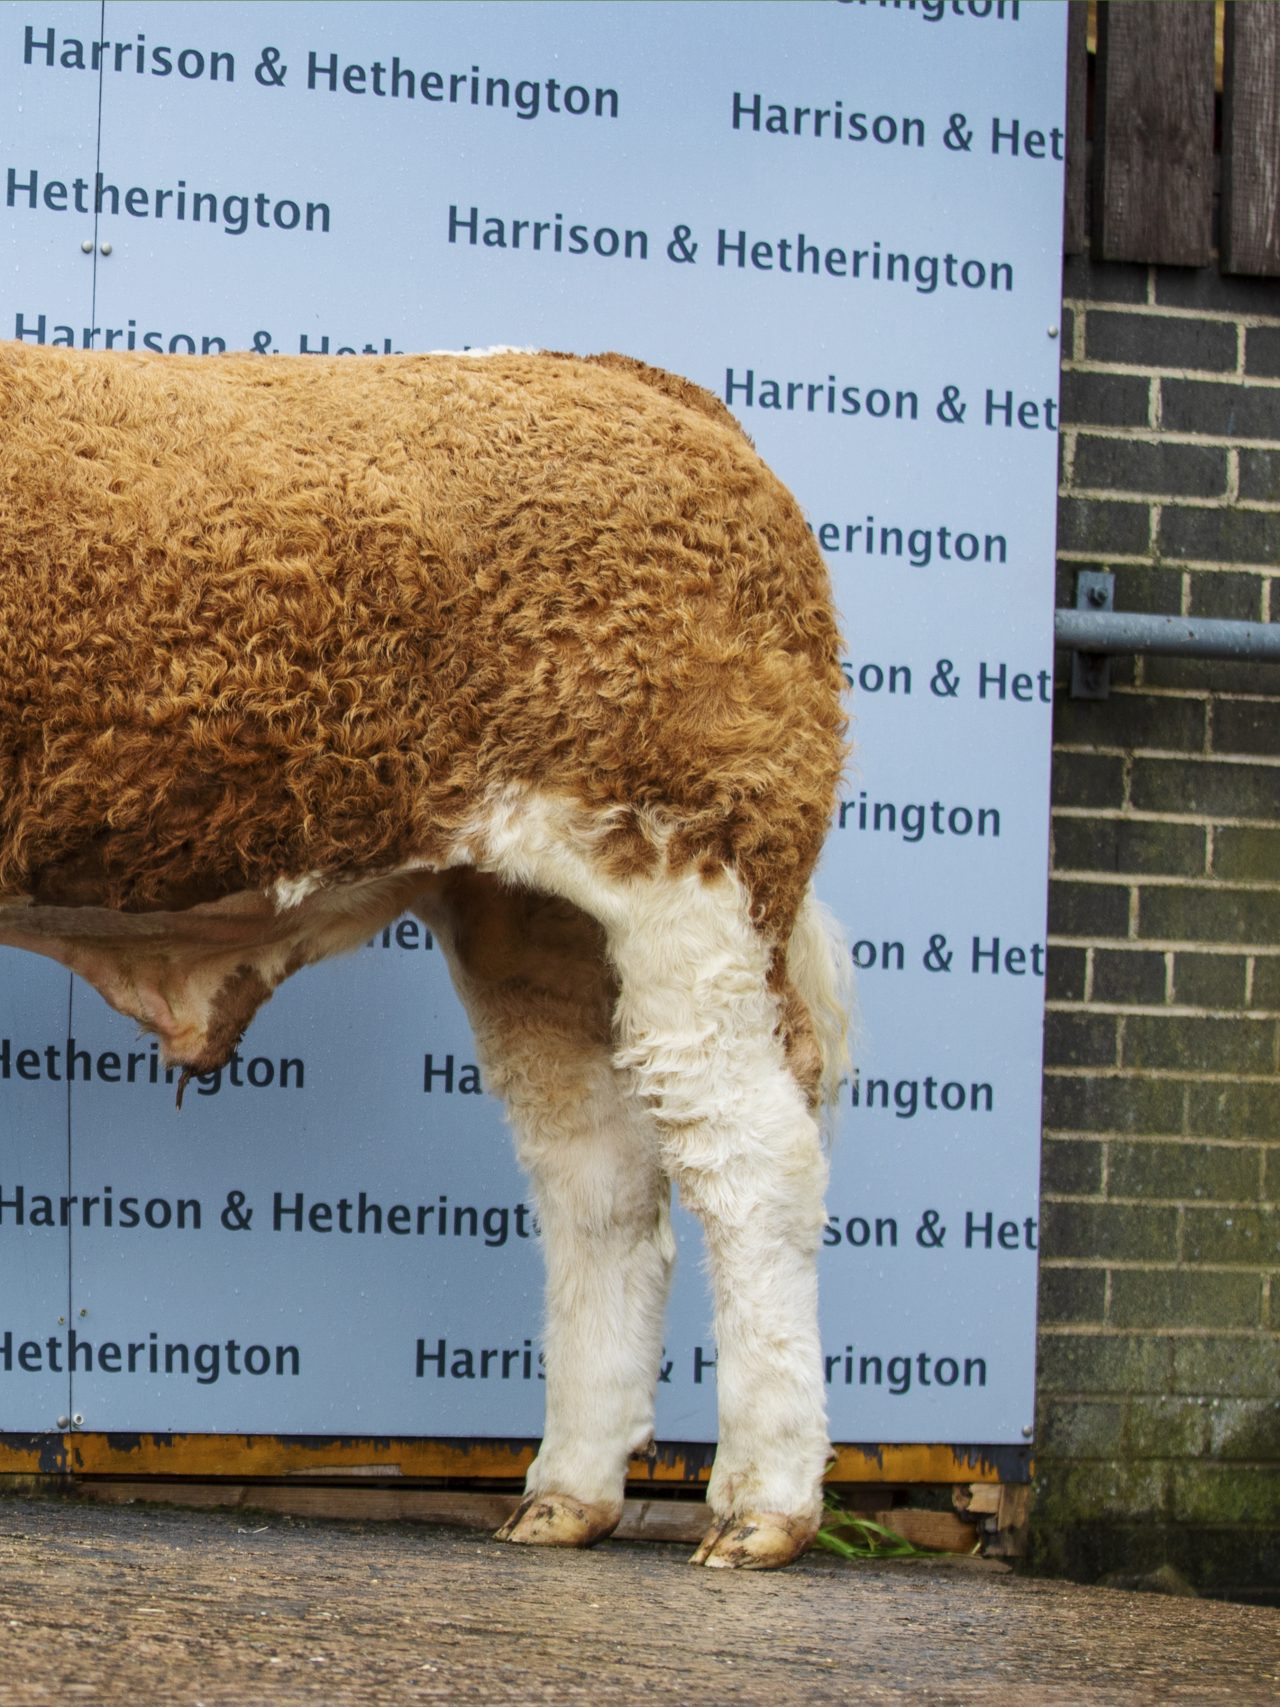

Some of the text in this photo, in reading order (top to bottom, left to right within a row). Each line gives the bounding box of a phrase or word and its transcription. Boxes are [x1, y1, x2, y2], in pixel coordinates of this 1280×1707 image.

[23, 25, 619, 120] Harrison & Hetherington
[732, 91, 1064, 161] Harrison & Het
[6, 166, 330, 235] Hetherington
[448, 204, 1013, 294] Harrison & Hetherington
[725, 367, 1058, 431] Harrison & Het
[930, 658, 961, 698] &
[979, 662, 1052, 704] Het
[922, 933, 953, 973] &
[972, 936, 1045, 977] Het
[220, 1190, 253, 1231] &
[272, 1191, 542, 1248] Hetheringt
[916, 1209, 947, 1249] &
[965, 1211, 1038, 1251] Het
